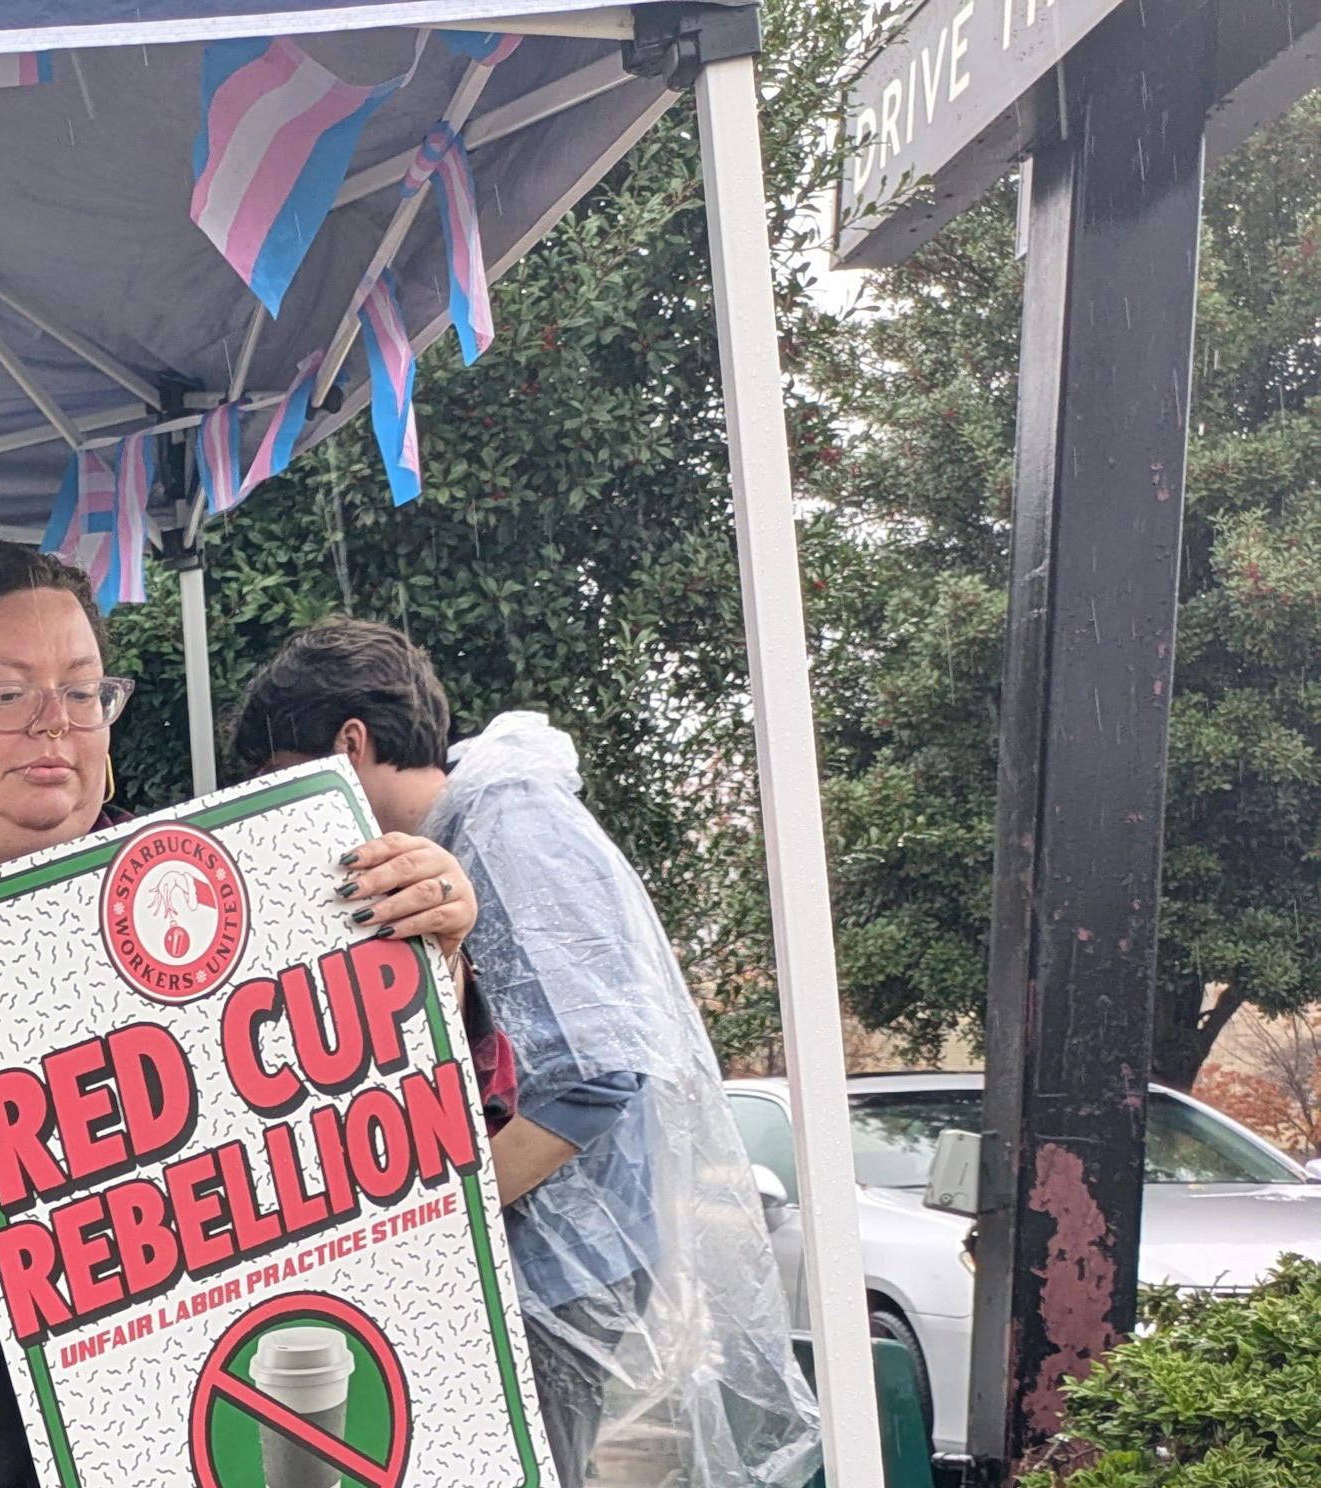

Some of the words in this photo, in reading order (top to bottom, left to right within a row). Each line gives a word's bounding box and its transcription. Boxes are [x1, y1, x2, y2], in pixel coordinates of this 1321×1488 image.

[853, 1, 974, 195] DRIVE
[116, 837, 218, 899] STARBUCKS
[206, 884, 238, 974] UNITED
[115, 916, 194, 990] WORKERS
[220, 938, 426, 1116] CUP
[61, 1315, 153, 1370] UNFAIR
[158, 1281, 242, 1331] LABOR
[247, 1232, 367, 1297] PRACTICE
[371, 1193, 458, 1246] STRIKE
